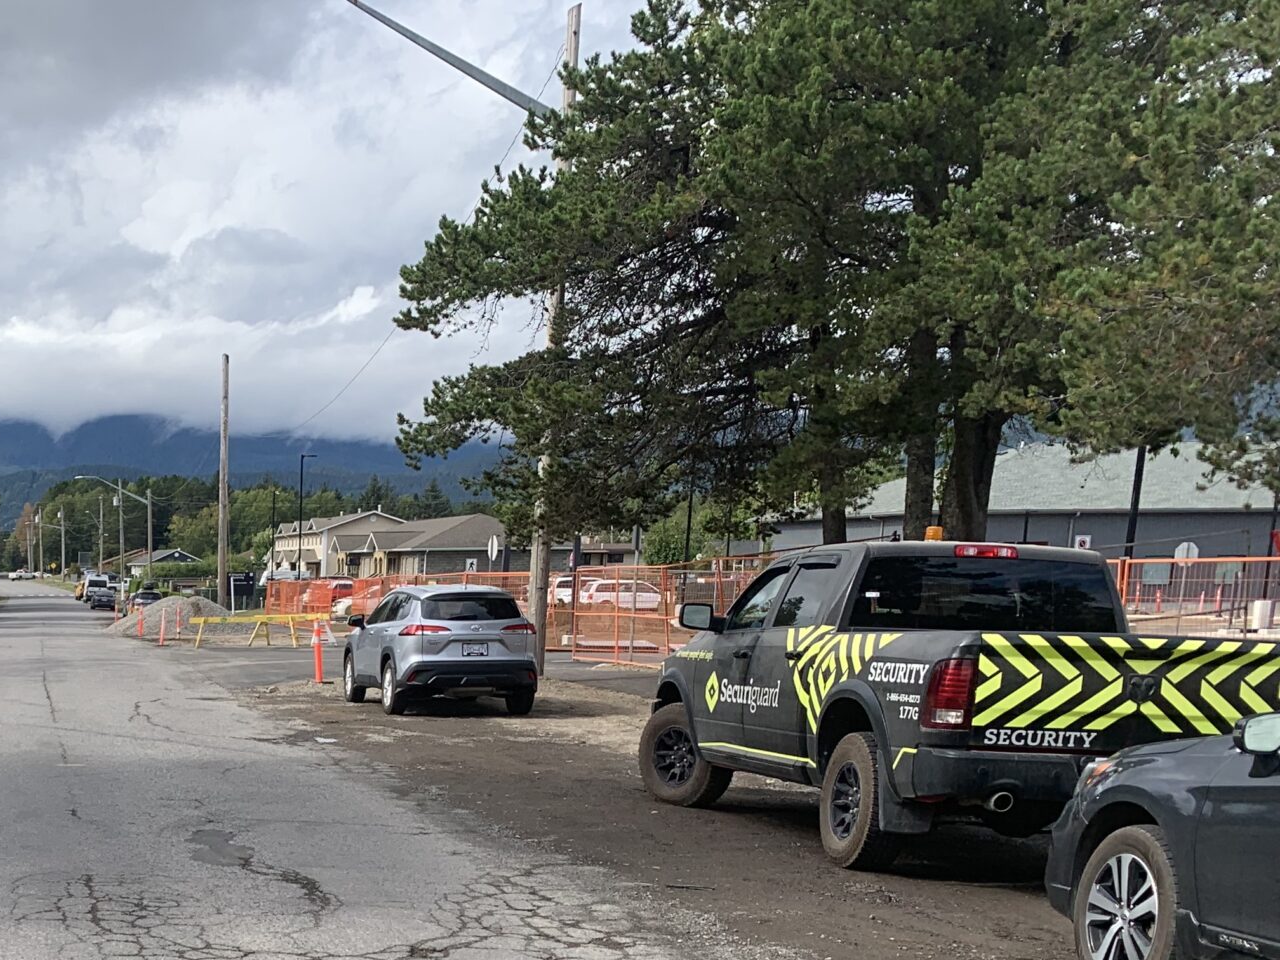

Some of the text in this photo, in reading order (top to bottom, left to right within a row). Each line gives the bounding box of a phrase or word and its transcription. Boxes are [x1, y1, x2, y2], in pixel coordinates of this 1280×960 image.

[868, 661, 930, 684] SECURITY
[720, 678, 781, 713] Securiguard
[899, 705, 919, 720] 177G
[983, 728, 1098, 748] SECURITY
